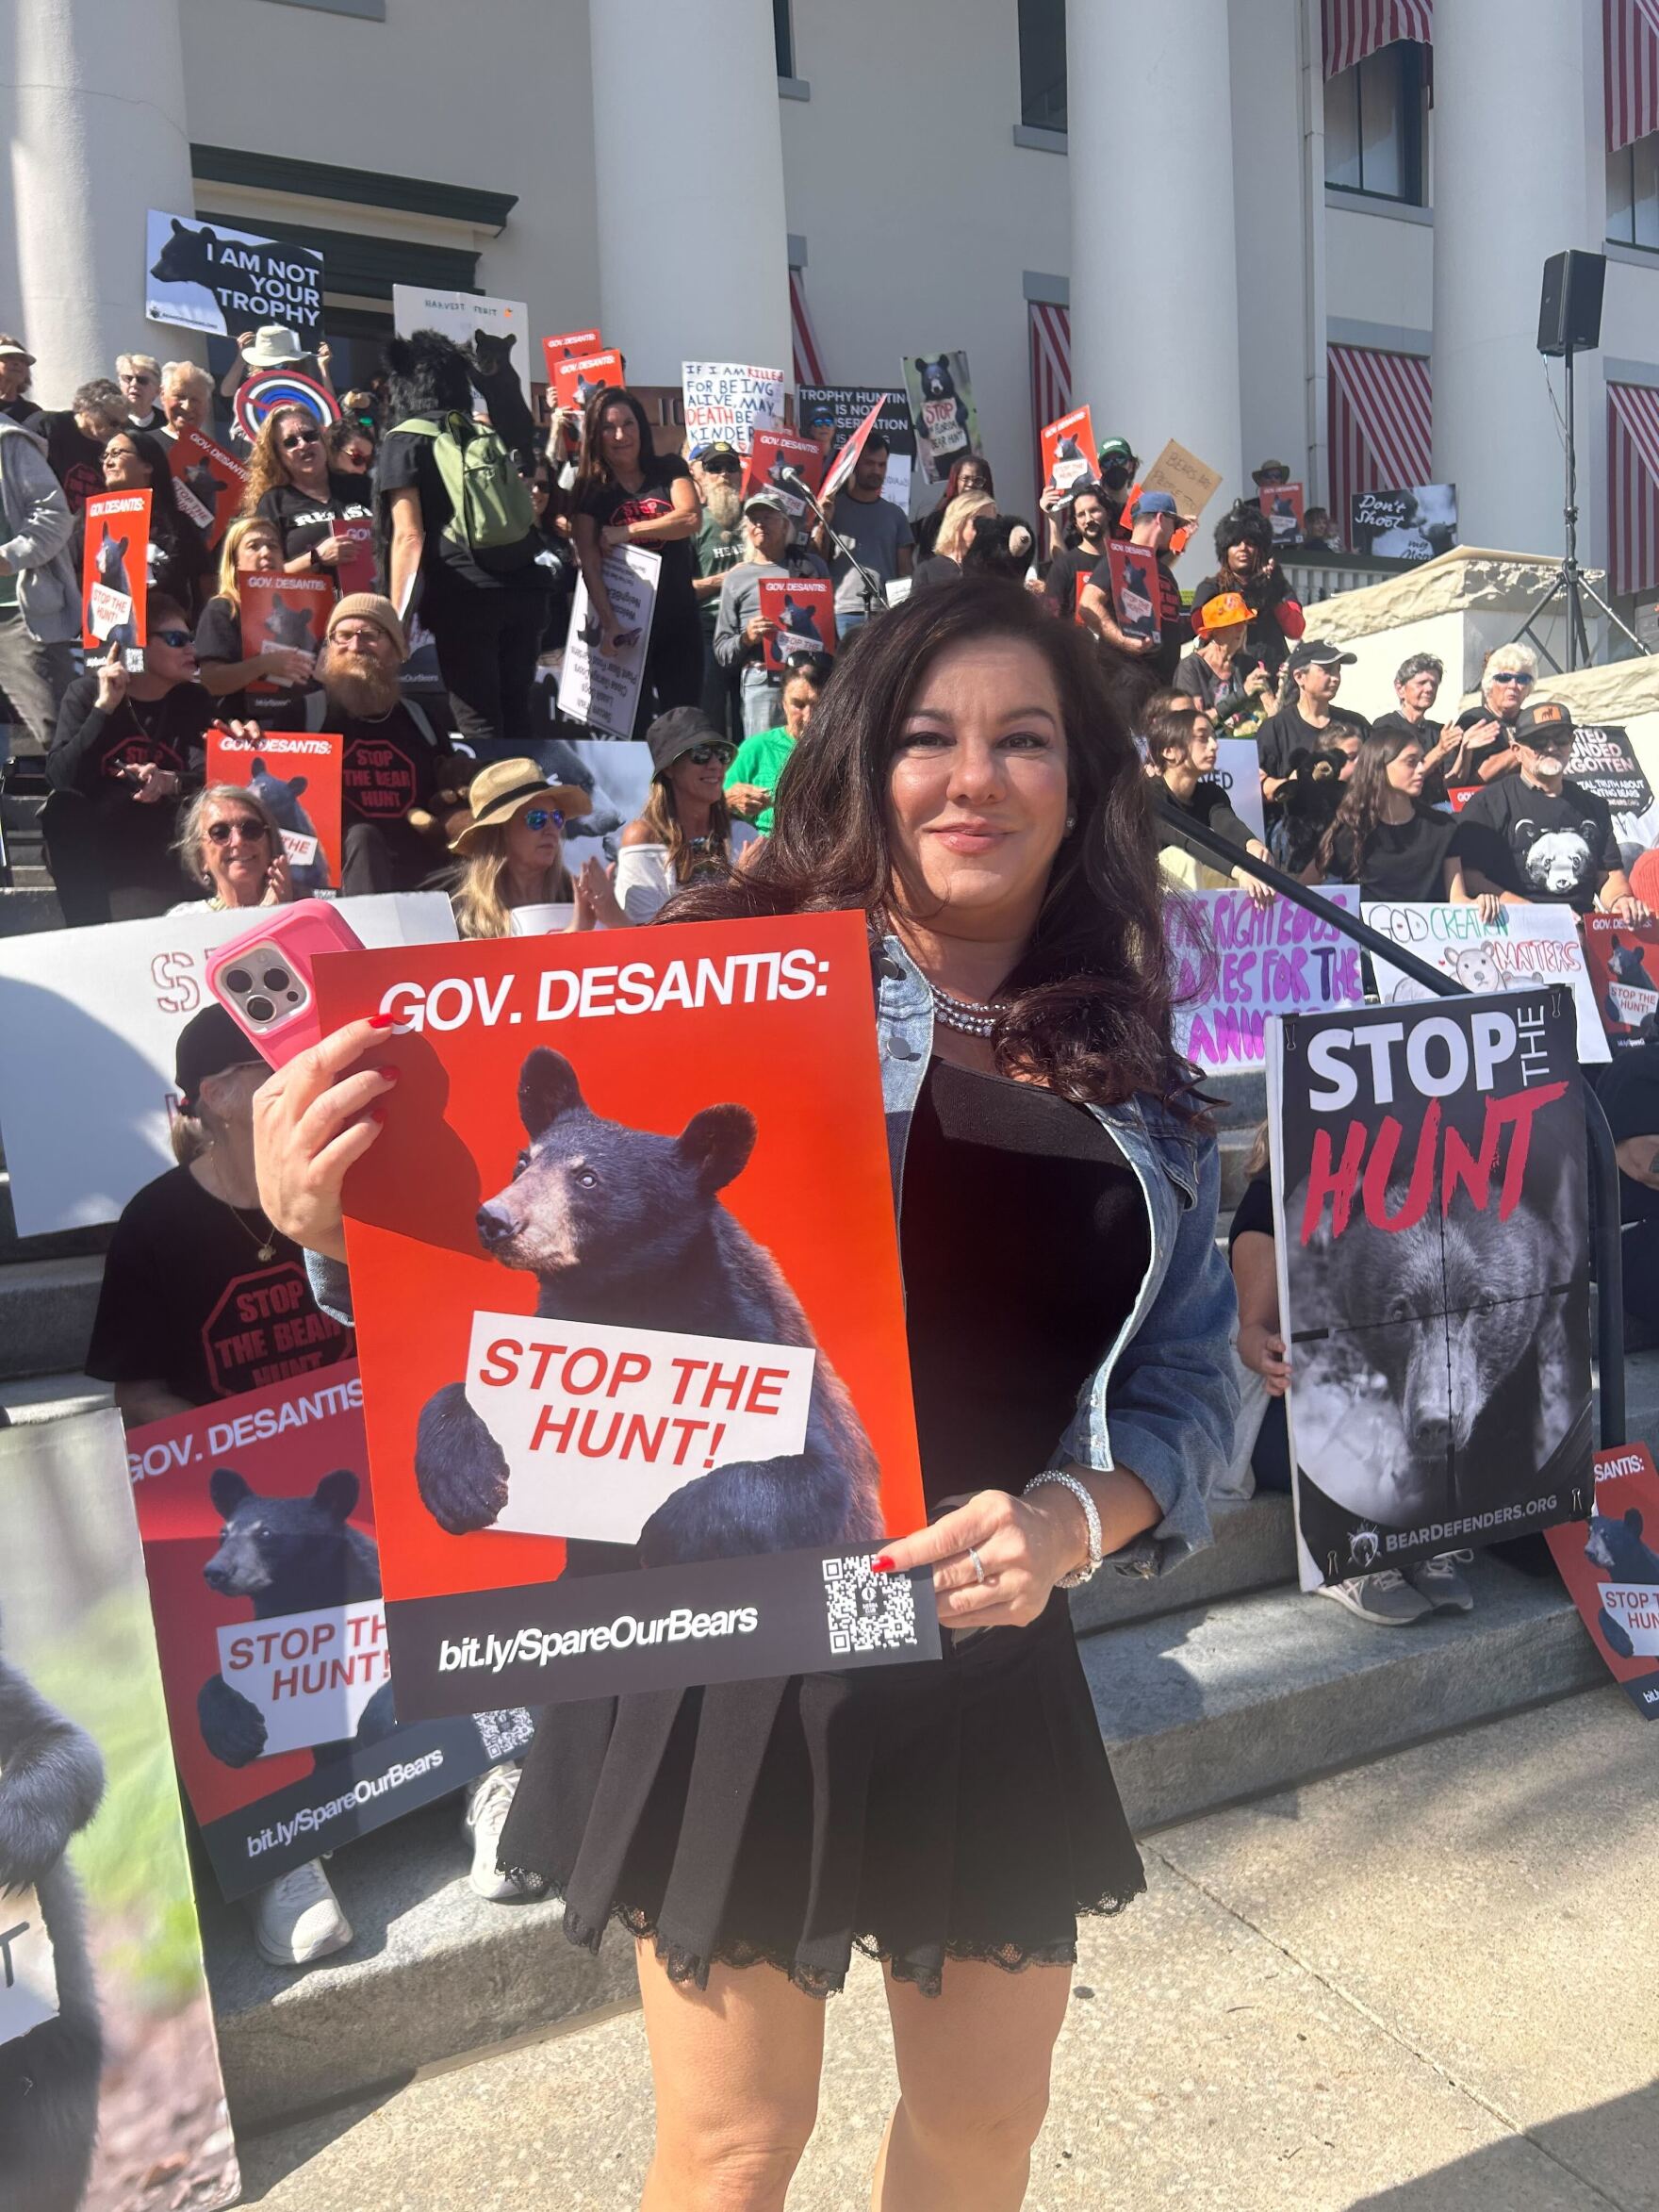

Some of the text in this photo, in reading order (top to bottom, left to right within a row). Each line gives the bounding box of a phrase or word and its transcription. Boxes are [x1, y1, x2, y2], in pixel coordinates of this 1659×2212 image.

[206, 243, 320, 287] I AM NOT
[249, 274, 320, 307] YOUR
[217, 288, 320, 326] TROPHY
[424, 300, 466, 311] HARVEST
[686, 365, 702, 374] IF
[709, 366, 716, 374] I
[723, 367, 745, 375] AM
[687, 379, 774, 396] FOR BEING
[801, 389, 906, 404] TROPHY HUNTIN
[686, 406, 734, 425] DEATH
[735, 411, 753, 423] BE
[835, 404, 846, 415] IS
[926, 403, 953, 424] STOP
[690, 426, 754, 442] KINDER
[761, 435, 780, 447] GOV.
[780, 438, 819, 454] DESANTIS:
[1358, 495, 1406, 513] Don't
[1355, 510, 1404, 528] Shoot
[248, 577, 326, 591] GOV. DESANTIS:
[765, 583, 827, 592] GOV. DESANTIS:
[93, 588, 128, 614] STOP THE
[126, 746, 163, 765] STP
[257, 739, 331, 755] DESANTIS:
[356, 750, 393, 767] STOP
[344, 769, 411, 787] THE BEAR
[361, 791, 400, 807] HUNT
[1369, 904, 1428, 943] GOD
[1593, 918, 1612, 931] GOV.
[1494, 940, 1581, 972] MATTERS
[1262, 947, 1311, 1004] FOR
[1310, 947, 1363, 1002] THE
[379, 949, 830, 1035] GOV. DESANTIS:
[1611, 986, 1656, 1004] STOP THE
[1620, 1000, 1649, 1013] HUNT!
[1517, 1005, 1550, 1086] THE
[1307, 1011, 1517, 1112] STOP
[1300, 1081, 1569, 1246] HUNT
[237, 1280, 304, 1323] STOP
[214, 1312, 342, 1368] THE BEAR
[479, 1339, 790, 1415] STOP THE
[126, 1378, 364, 1485] GOV. DESANTIS
[529, 1405, 726, 1469] HUNT!
[1594, 1454, 1644, 1482] SANTIS:
[1386, 1494, 1557, 1553] BEARDEFENDERS.ORG
[1605, 1591, 1649, 1609] STOP
[1628, 1611, 1659, 1628] HUN
[229, 1614, 388, 1670] STOP TH
[438, 1607, 758, 1674] bit.ly/SpareOurBears
[271, 1651, 391, 1701] HUNT!
[247, 1749, 443, 1857] bit.ly/SpareOurBears
